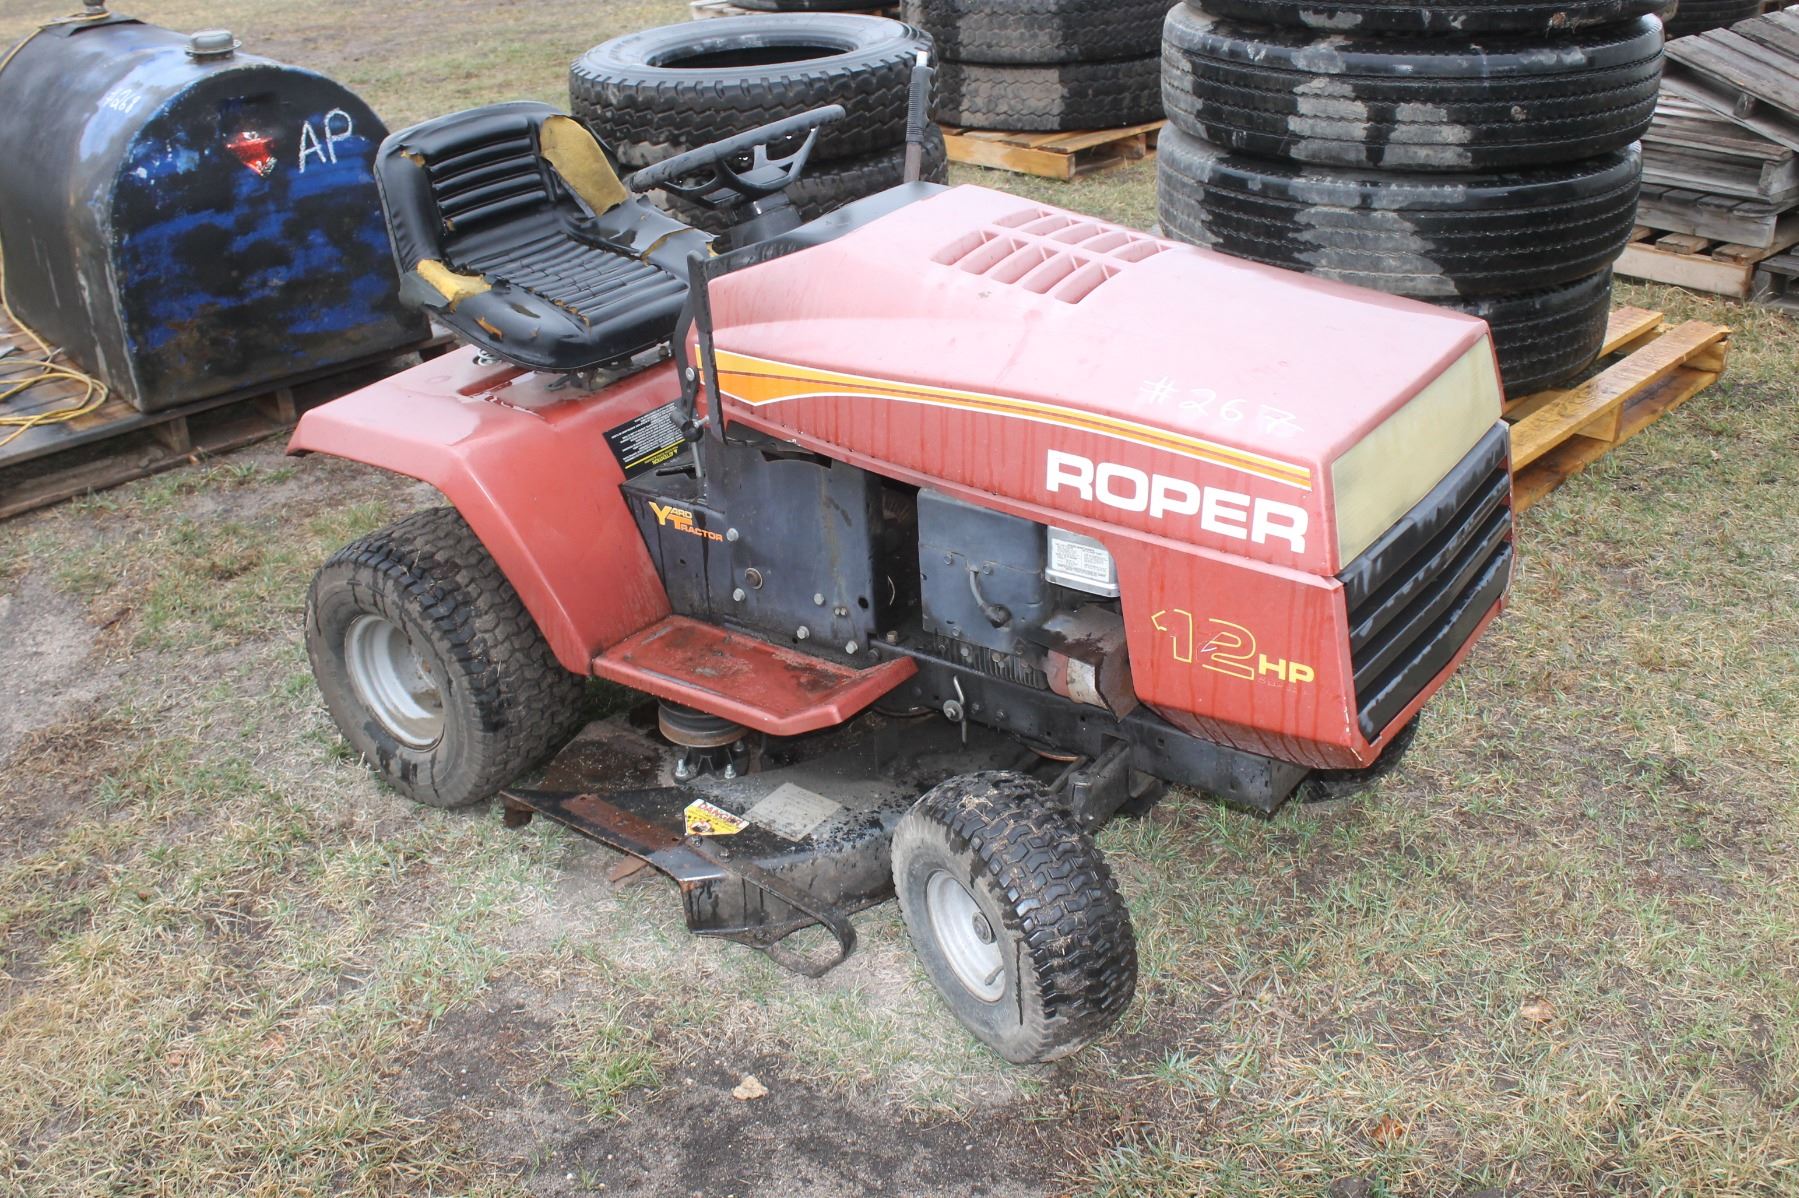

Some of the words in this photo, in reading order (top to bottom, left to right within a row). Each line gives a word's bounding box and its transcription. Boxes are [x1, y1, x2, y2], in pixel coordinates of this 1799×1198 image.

[299, 107, 353, 173] AP
[1139, 376, 1304, 433] #267
[648, 501, 692, 525] YARD
[667, 514, 723, 542] TRACTOR
[1046, 449, 1308, 553] ROPER
[1151, 608, 1255, 680] 12
[1258, 653, 1314, 683] HP
